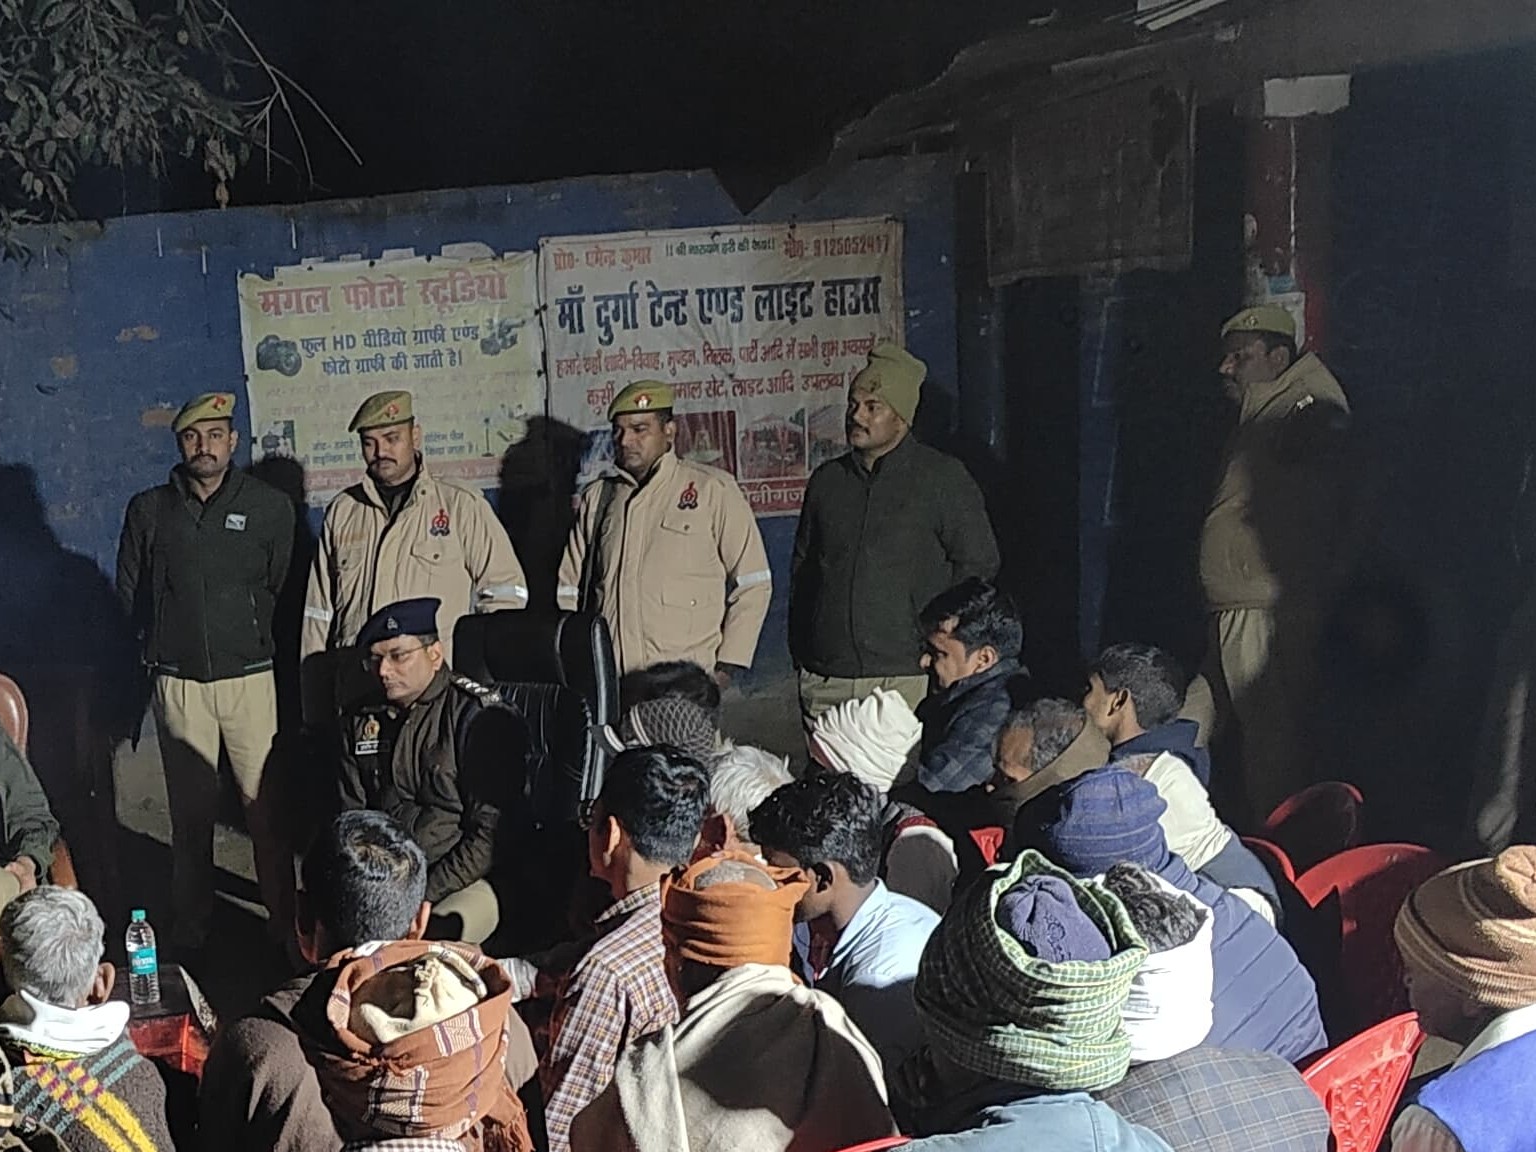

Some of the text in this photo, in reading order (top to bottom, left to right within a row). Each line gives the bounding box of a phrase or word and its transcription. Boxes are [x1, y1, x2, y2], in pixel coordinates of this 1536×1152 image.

[620, 247, 652, 271] कुमार
[341, 276, 406, 312] फोटो
[417, 270, 508, 312] स्टूडियो
[593, 280, 639, 346] दुर्गा
[645, 280, 688, 328] टेन्ट
[695, 286, 745, 324] एण्ड
[752, 281, 814, 325] लाइट
[821, 276, 882, 317] हाउस
[300, 325, 480, 359] फुल HD वीडियो ग्राफी एण्ड
[760, 338, 783, 363] आदि
[821, 340, 839, 367] शुभ
[322, 353, 350, 376] फोटो
[356, 352, 386, 373] ग्राफी
[391, 351, 408, 371] की
[413, 350, 444, 370] जाती
[731, 378, 765, 398] लाइट
[766, 369, 794, 395] आदि
[801, 372, 844, 392] उपलब्ध
